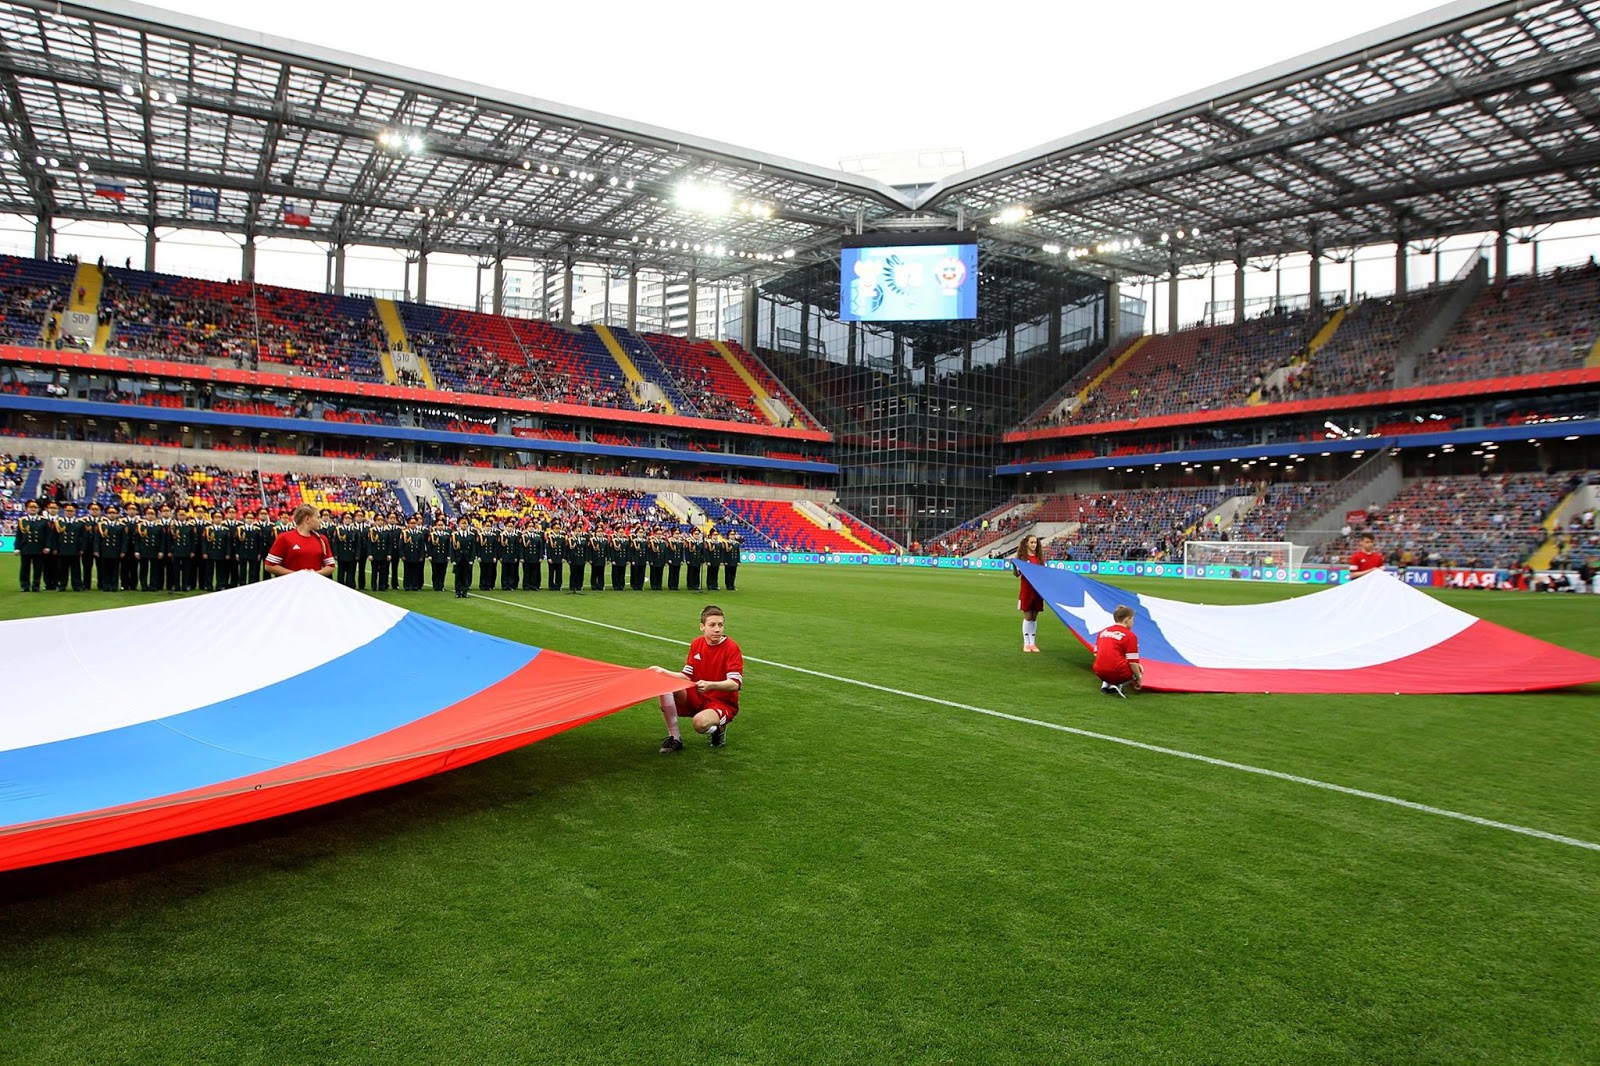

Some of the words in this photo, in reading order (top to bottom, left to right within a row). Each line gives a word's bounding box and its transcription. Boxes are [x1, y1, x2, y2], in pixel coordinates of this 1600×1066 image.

[192, 194, 216, 207] FIFA
[72, 313, 90, 324] 509
[396, 353, 410, 362] 510
[57, 458, 76, 470] 209
[409, 478, 422, 488] 210
[1406, 571, 1428, 584] FM
